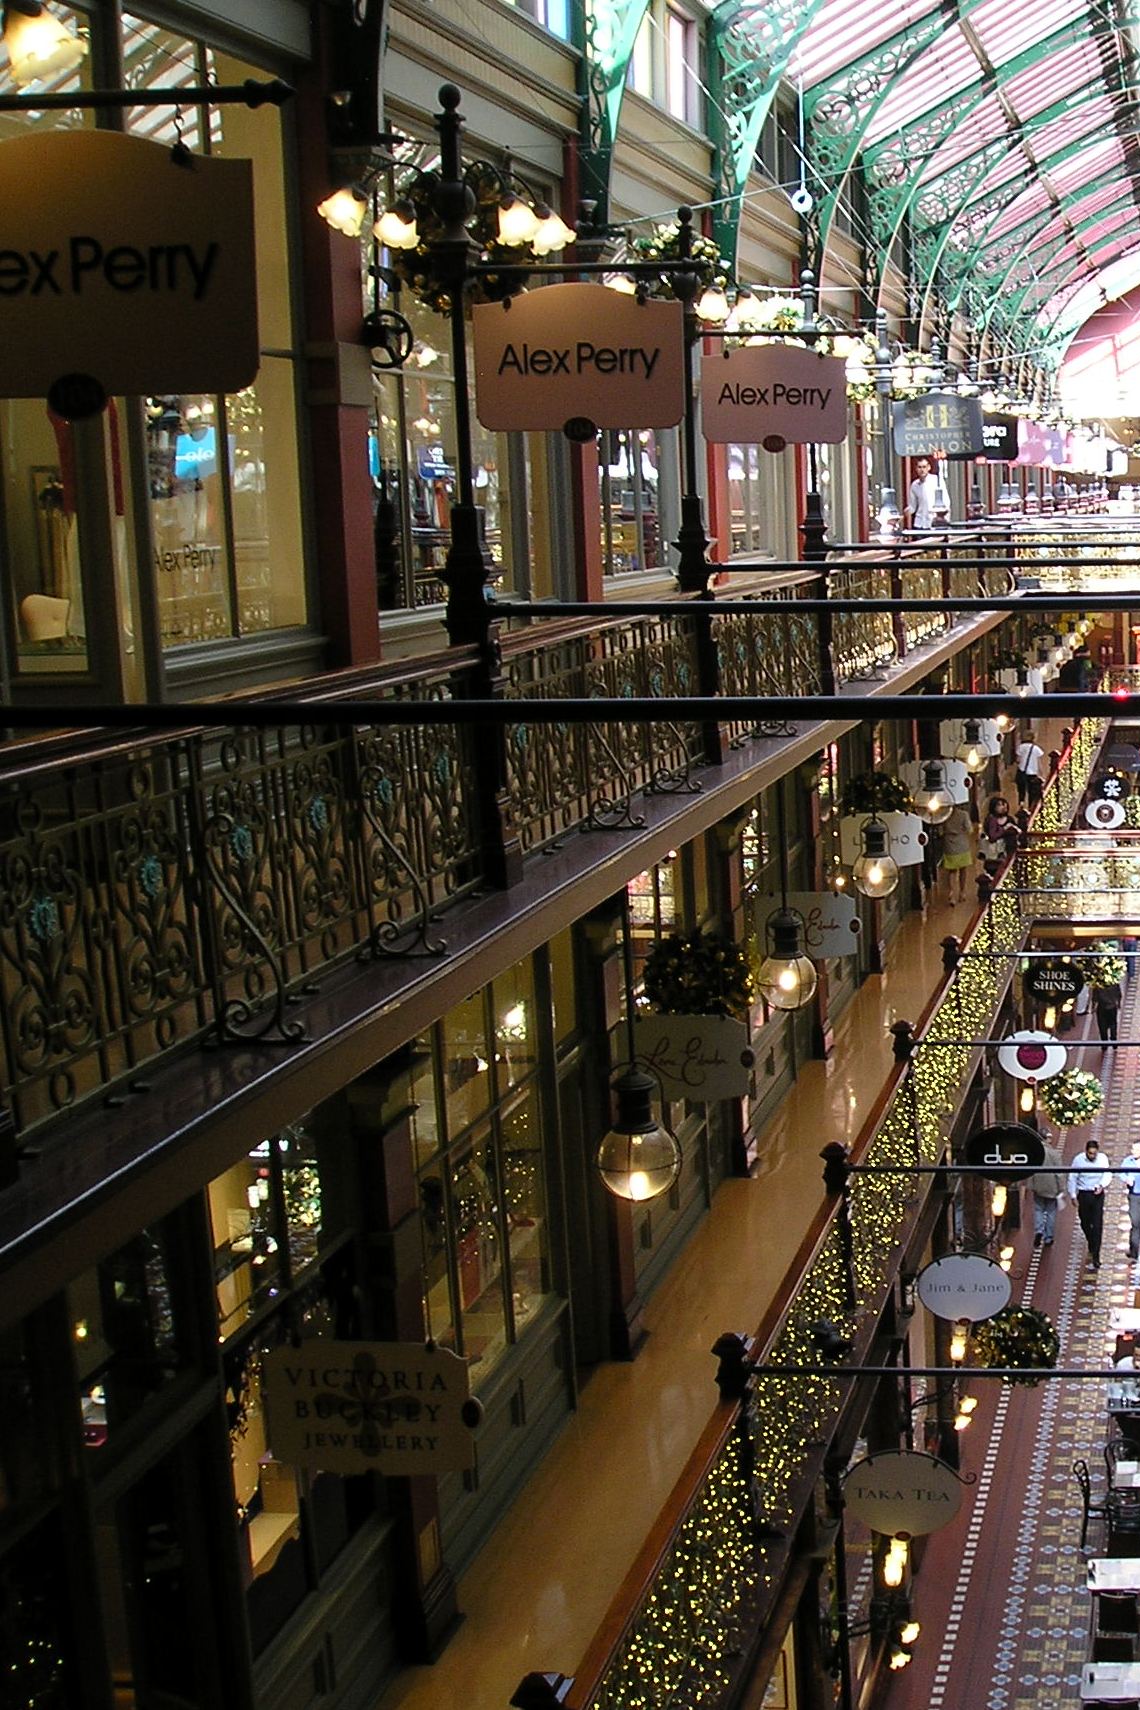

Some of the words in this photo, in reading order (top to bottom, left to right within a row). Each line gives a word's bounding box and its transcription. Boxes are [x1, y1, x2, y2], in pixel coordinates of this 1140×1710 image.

[69, 237, 220, 302] Perry
[497, 343, 572, 377] Alex
[576, 342, 661, 380] Perry
[718, 383, 770, 406] Alex
[773, 383, 832, 410] Perry
[905, 431, 970, 443] CHRISTOPHER
[905, 441, 973, 455] HANLON
[1039, 971, 1071, 981] SHOE
[1033, 981, 1075, 992] SHINES
[984, 1144, 1029, 1165] duo
[926, 1282, 951, 1295] Jim
[956, 1284, 967, 1294] &
[972, 1282, 1005, 1295] Jane
[285, 1367, 447, 1392] VICTORIA
[295, 1399, 442, 1423] BUCKLEY
[303, 1431, 441, 1451] JEWELLERY
[854, 1487, 905, 1502] TAKA
[913, 1487, 951, 1503] TEA
